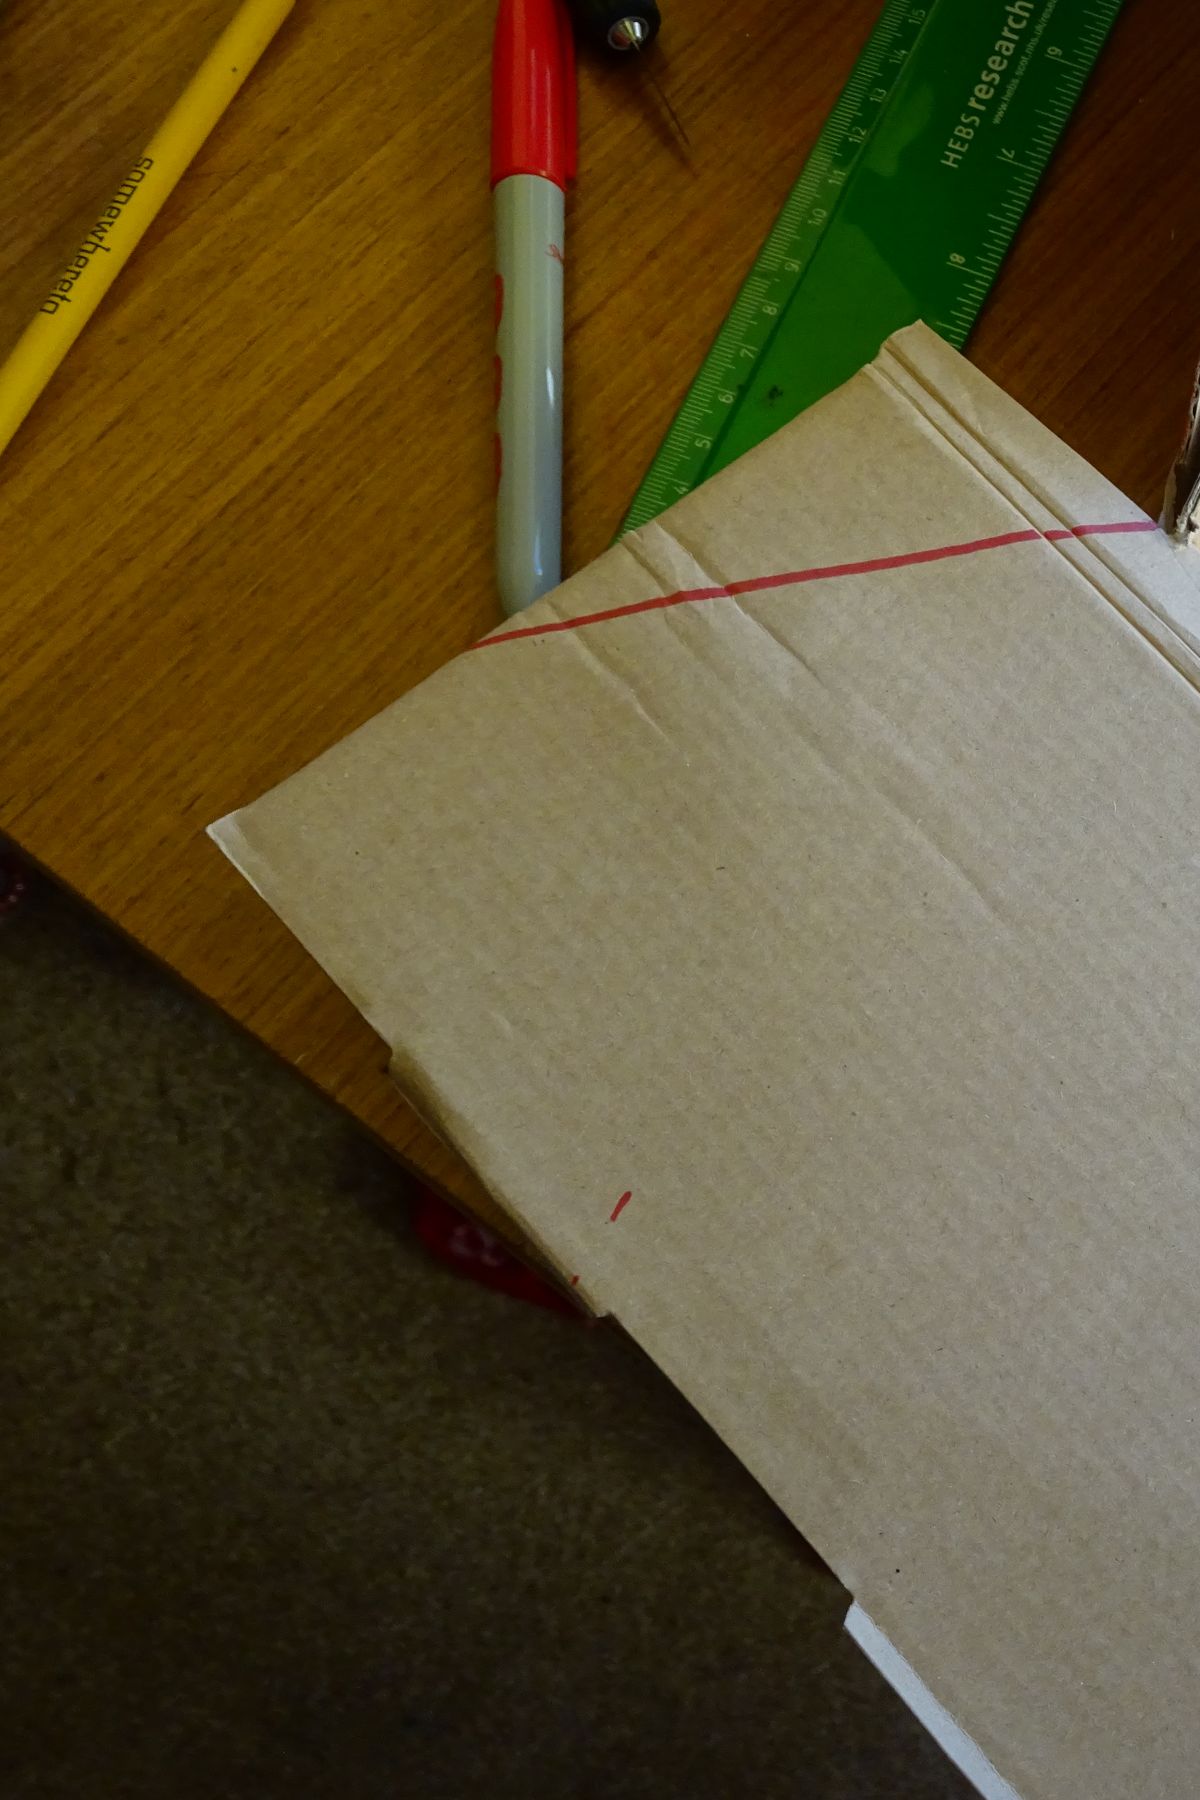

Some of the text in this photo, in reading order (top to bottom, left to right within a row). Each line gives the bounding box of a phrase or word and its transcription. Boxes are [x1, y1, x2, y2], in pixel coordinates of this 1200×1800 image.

[940, 0, 1034, 168] HEBS research
[1001, 147, 1016, 159] 7
[694, 437, 711, 449] 5
[717, 392, 734, 404] 6
[739, 348, 755, 359] 7
[761, 304, 777, 316] 8
[784, 261, 800, 273] 9
[807, 207, 828, 226] 10
[828, 169, 847, 186] 11
[848, 126, 867, 143] 12
[869, 87, 887, 103] 13
[888, 49, 908, 64] 14
[908, 8, 927, 25] 15
[949, 252, 967, 265] 8
